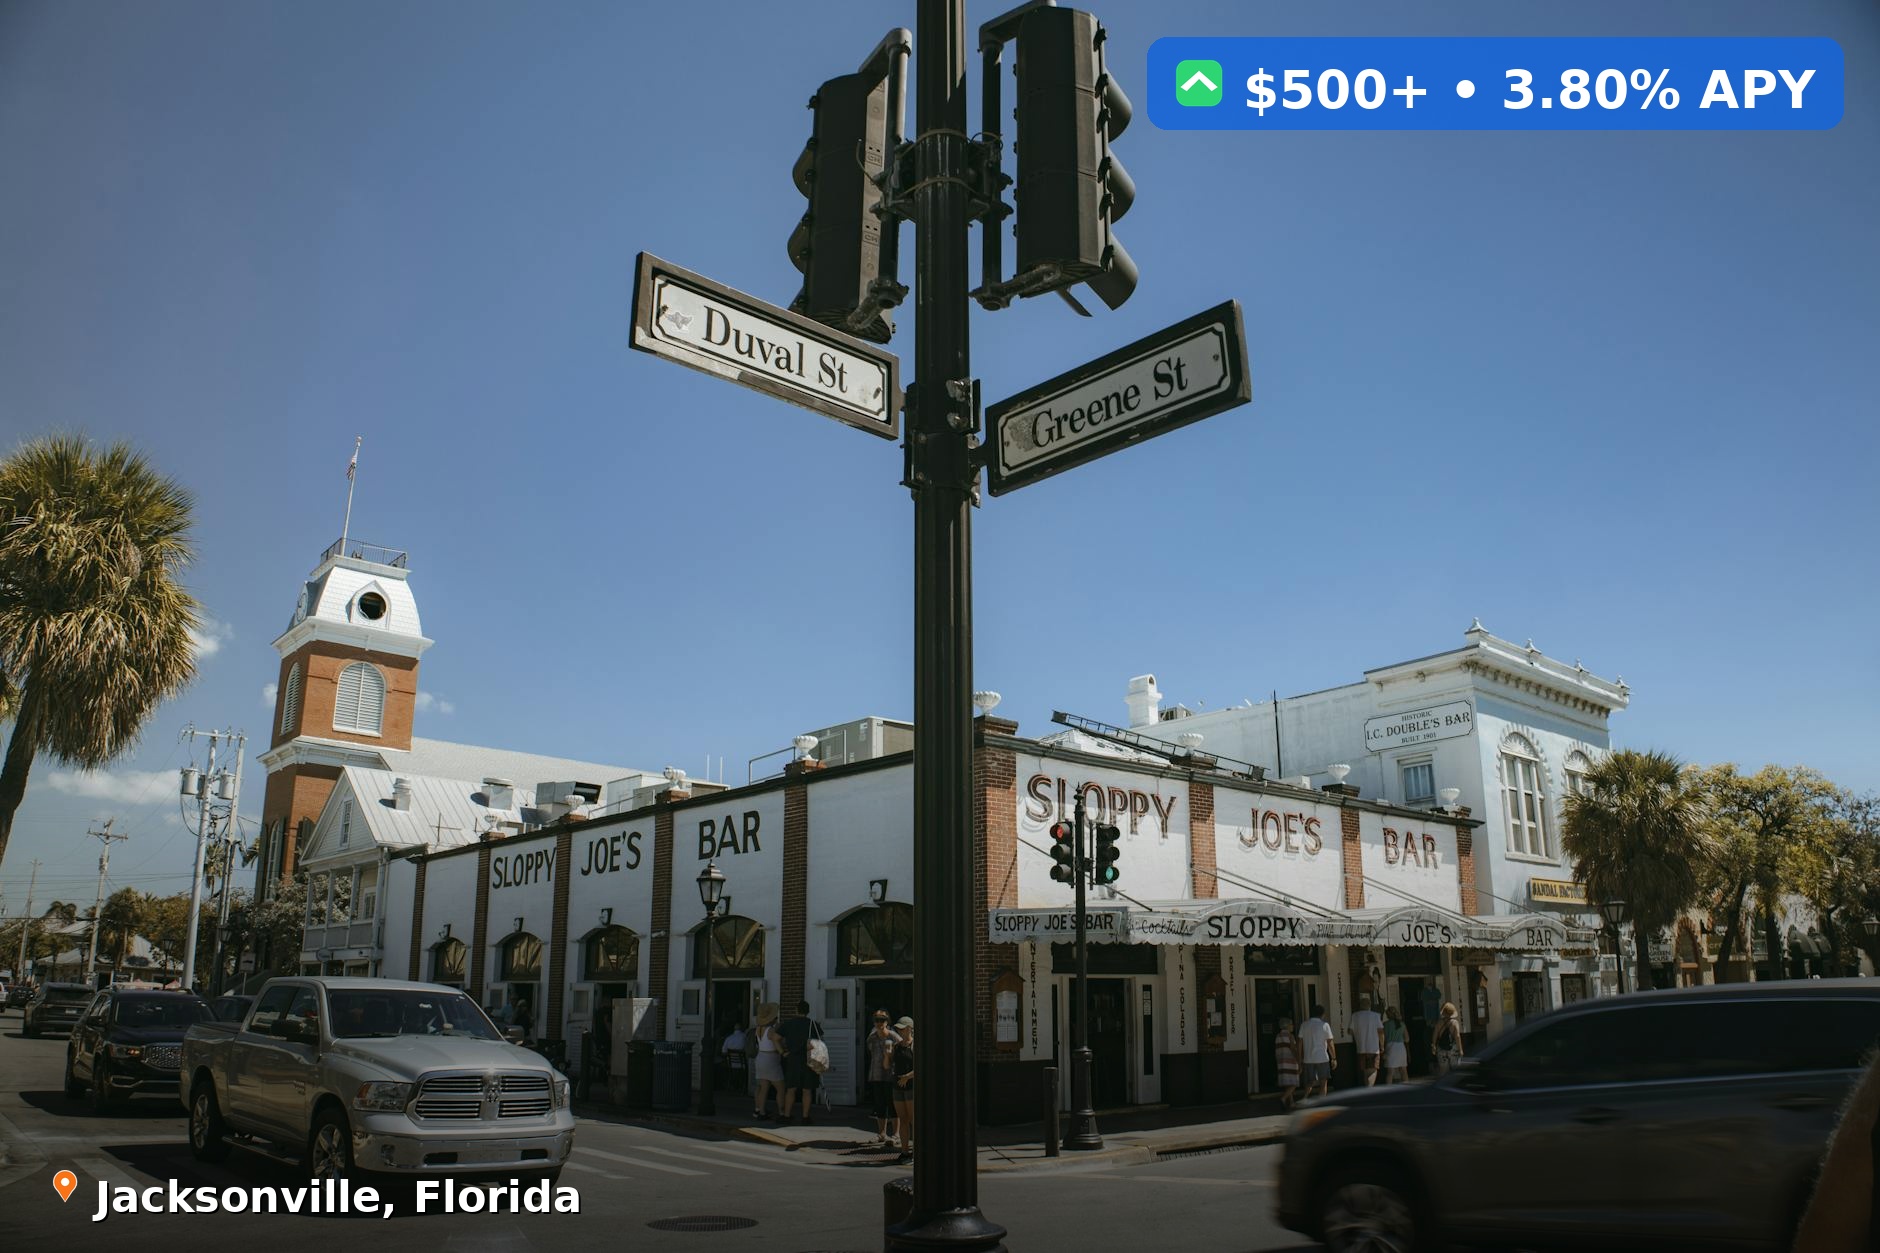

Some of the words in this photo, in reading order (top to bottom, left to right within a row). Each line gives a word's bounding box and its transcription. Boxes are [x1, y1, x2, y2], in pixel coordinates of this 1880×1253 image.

[703, 306, 806, 378] Duval
[818, 352, 848, 393] St
[1031, 384, 1141, 448] Greene
[1153, 356, 1188, 401] St
[1386, 717, 1441, 737] DOUBLE'S
[1445, 711, 1471, 727] BAR
[1401, 710, 1433, 721] HISTORIC
[1401, 735, 1420, 744] BUILT
[1025, 773, 1177, 839] SLOPPY
[1239, 807, 1324, 856] JOE'S
[1382, 826, 1438, 870] BAR
[491, 847, 558, 890] SLOPPY
[580, 830, 642, 877] JOE'S
[697, 810, 762, 860] BAR
[994, 914, 1040, 932] SLOPPY
[1044, 914, 1077, 931] JOE'S
[1084, 914, 1114, 930] BAR
[1207, 915, 1301, 939] SLOPPY
[1401, 923, 1452, 944] JOE'S
[1526, 928, 1553, 946] BAR
